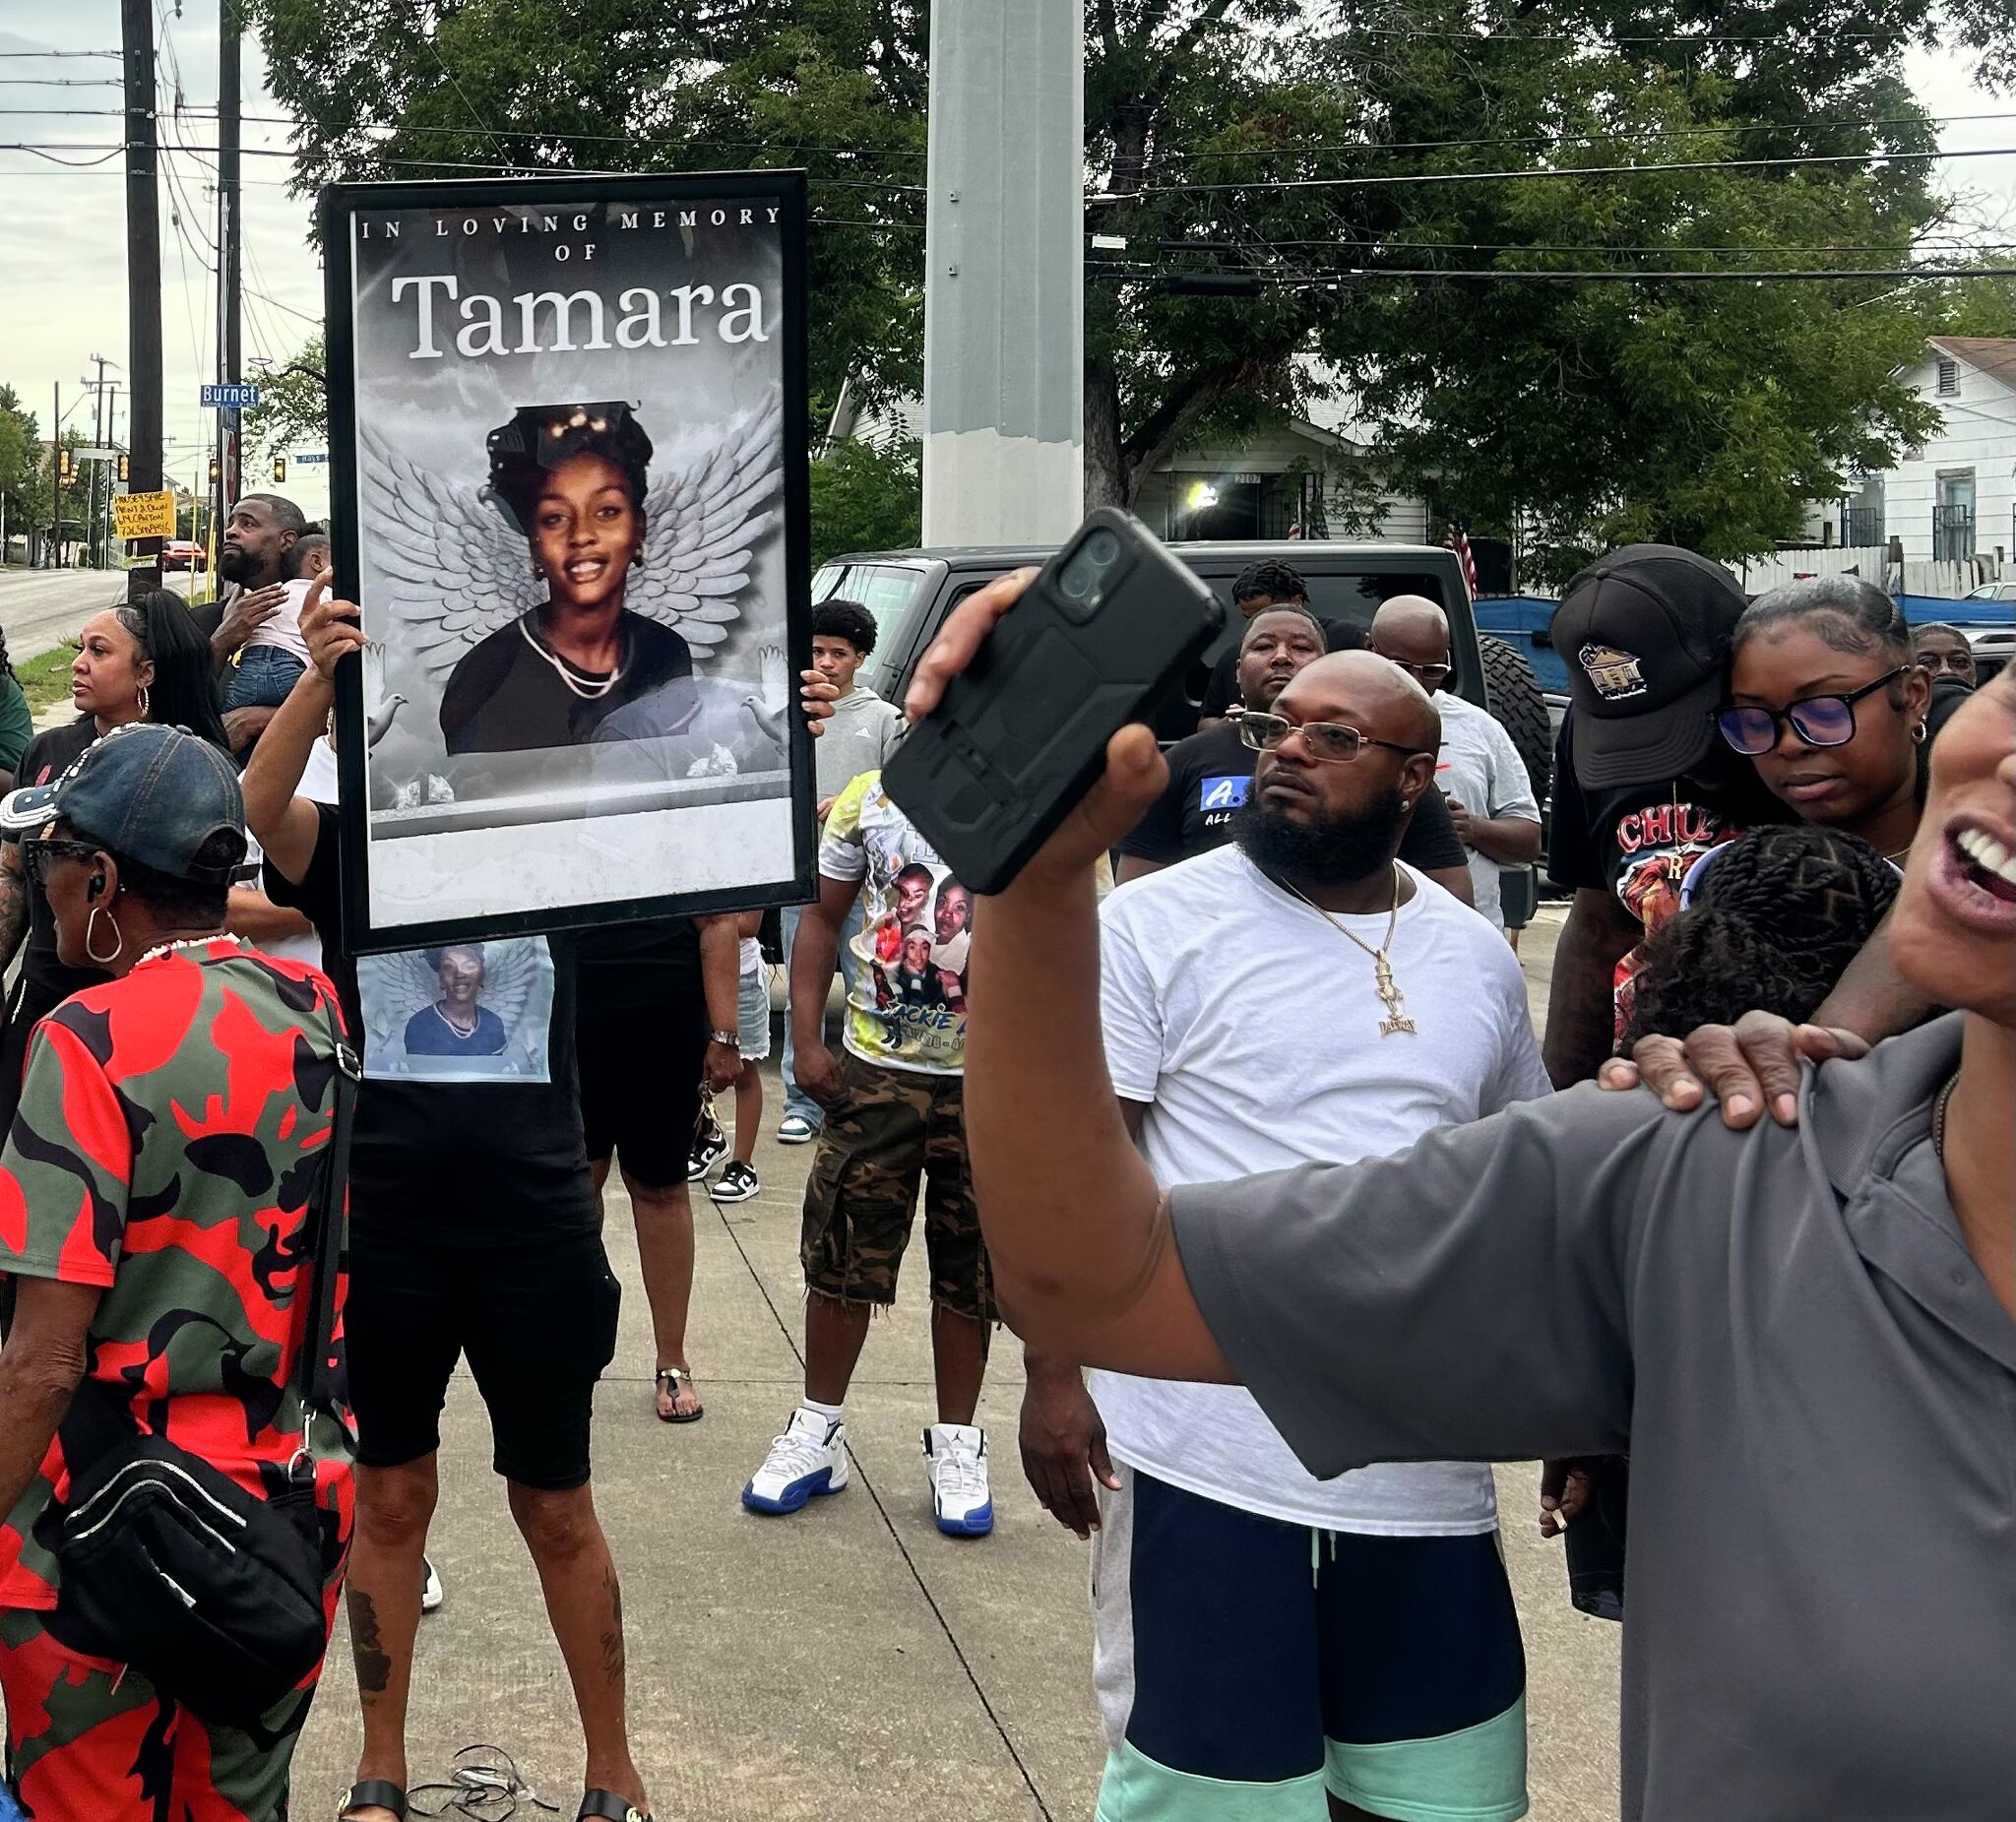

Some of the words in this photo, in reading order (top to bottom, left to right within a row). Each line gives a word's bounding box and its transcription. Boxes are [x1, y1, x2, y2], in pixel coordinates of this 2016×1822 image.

[361, 220, 401, 239] IN
[435, 214, 588, 237] LOVING
[620, 207, 781, 229] MEMORY
[554, 243, 597, 262] OF
[391, 275, 770, 359] Tamara
[203, 385, 256, 403] Burnet
[1205, 812, 1231, 826] ALL
